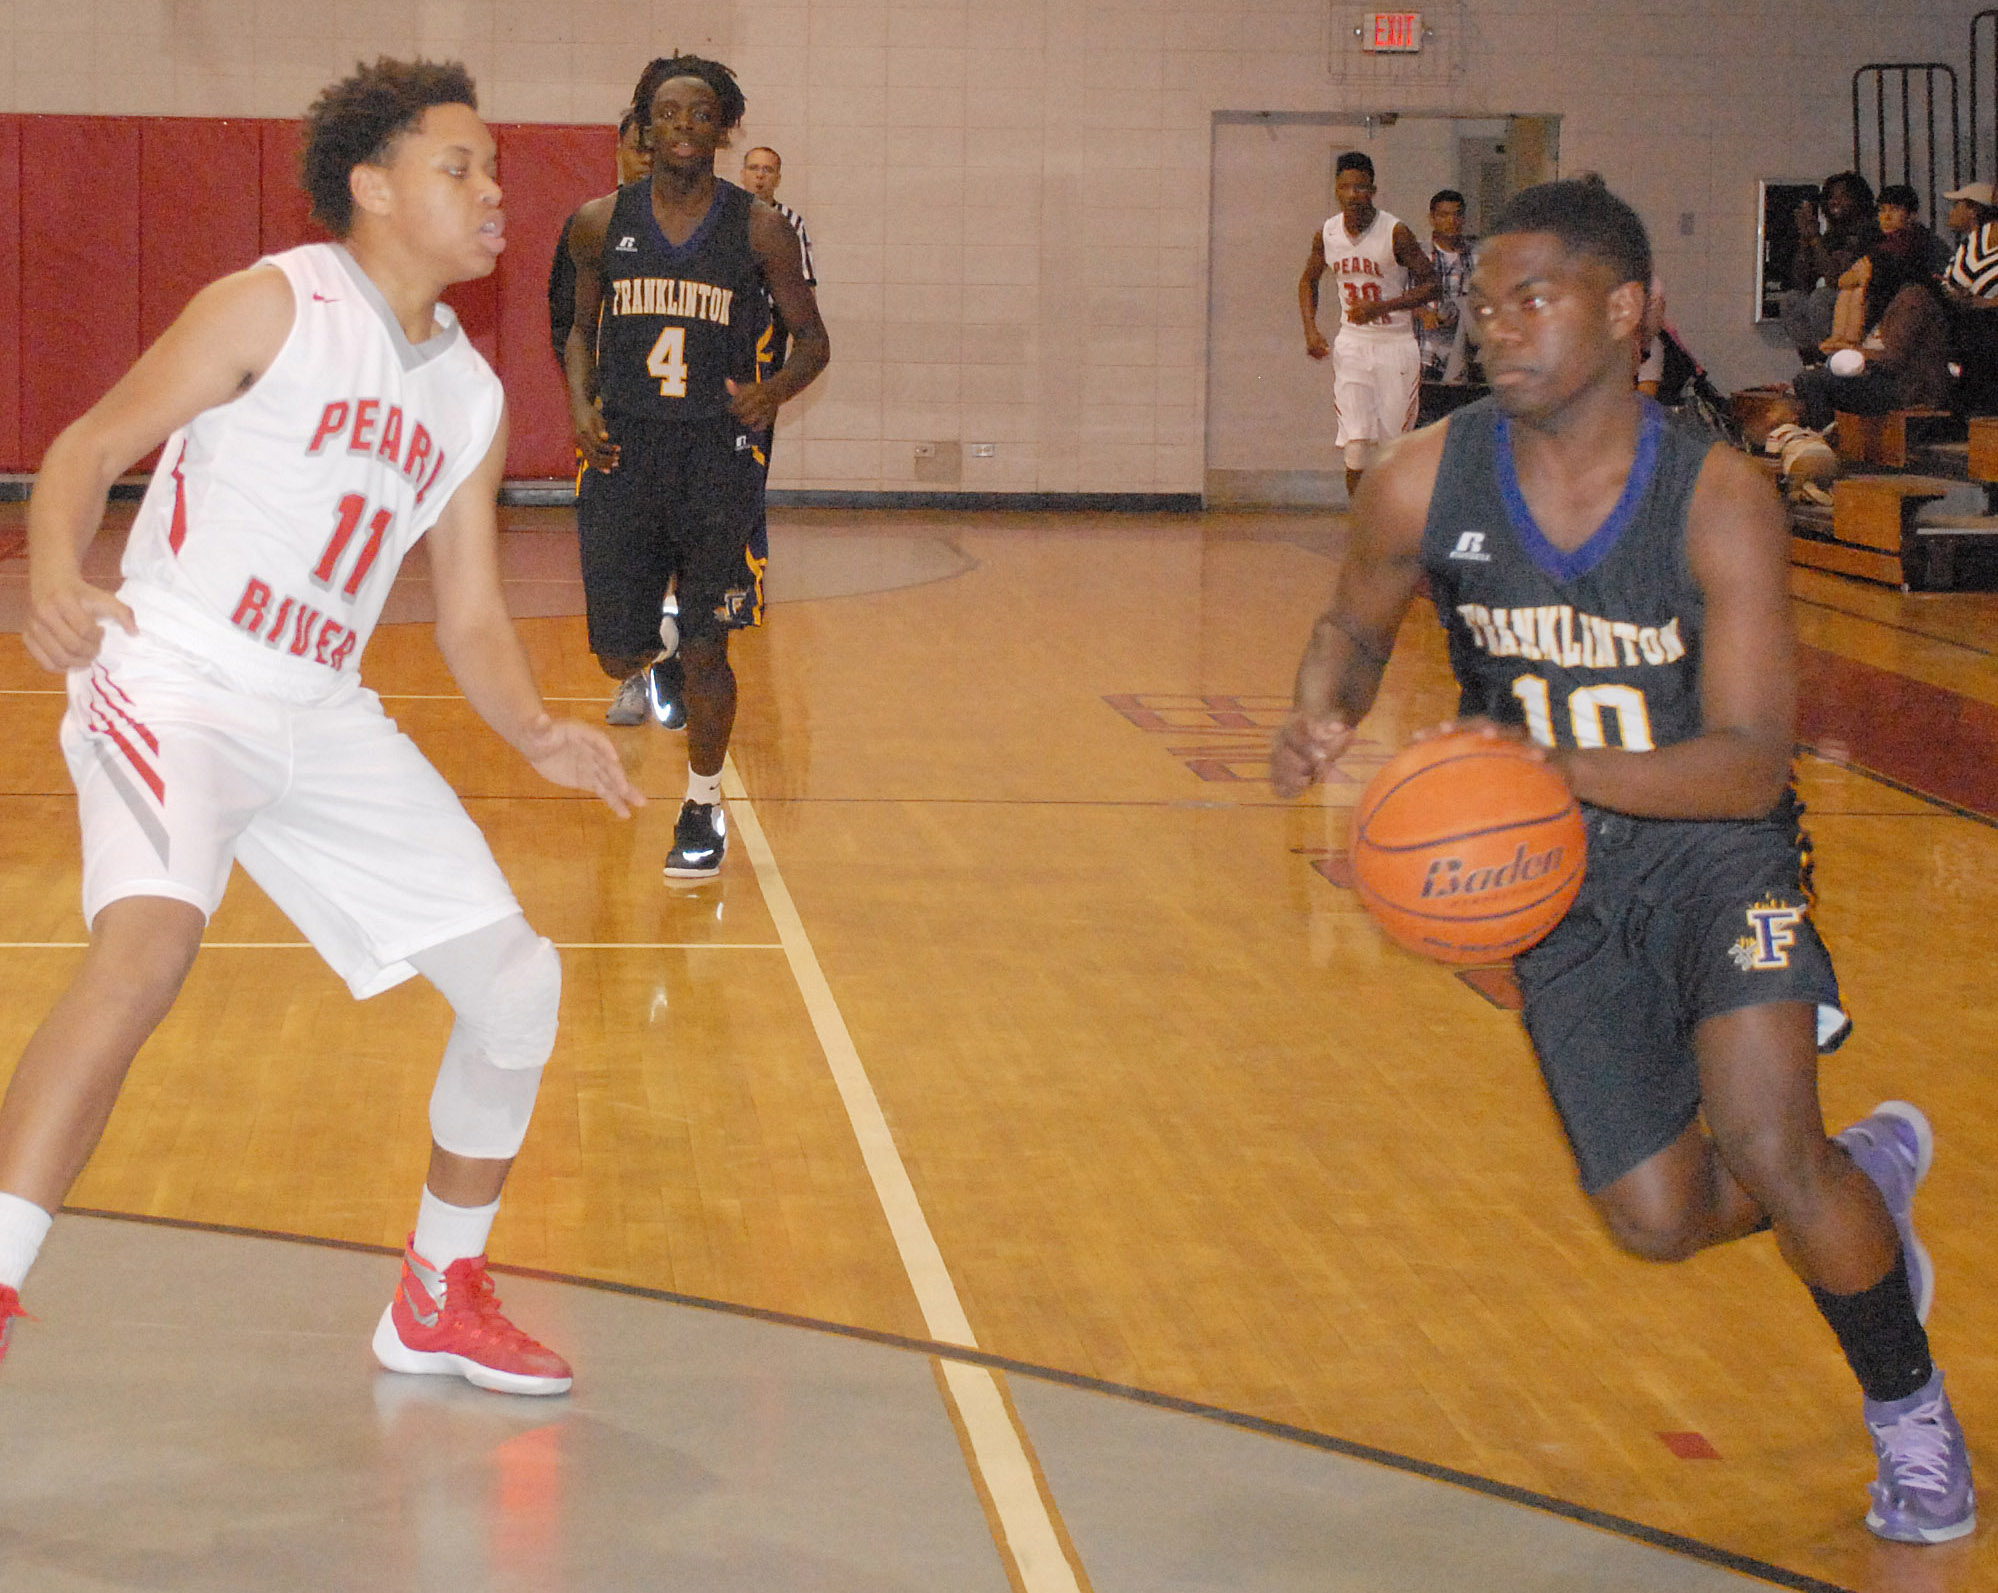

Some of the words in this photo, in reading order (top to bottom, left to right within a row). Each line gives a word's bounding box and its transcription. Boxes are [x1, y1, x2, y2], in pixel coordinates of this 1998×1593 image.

[1375, 14, 1416, 46] EXIT
[612, 277, 734, 326] FRANKLINTON
[646, 326, 688, 398] 4
[308, 490, 396, 605] 11
[230, 575, 357, 671] RIVER
[1457, 603, 1687, 668] FRANKLINTON
[1512, 673, 1657, 752] 10
[1421, 841, 1566, 898] Baden
[1746, 907, 1801, 970] F
